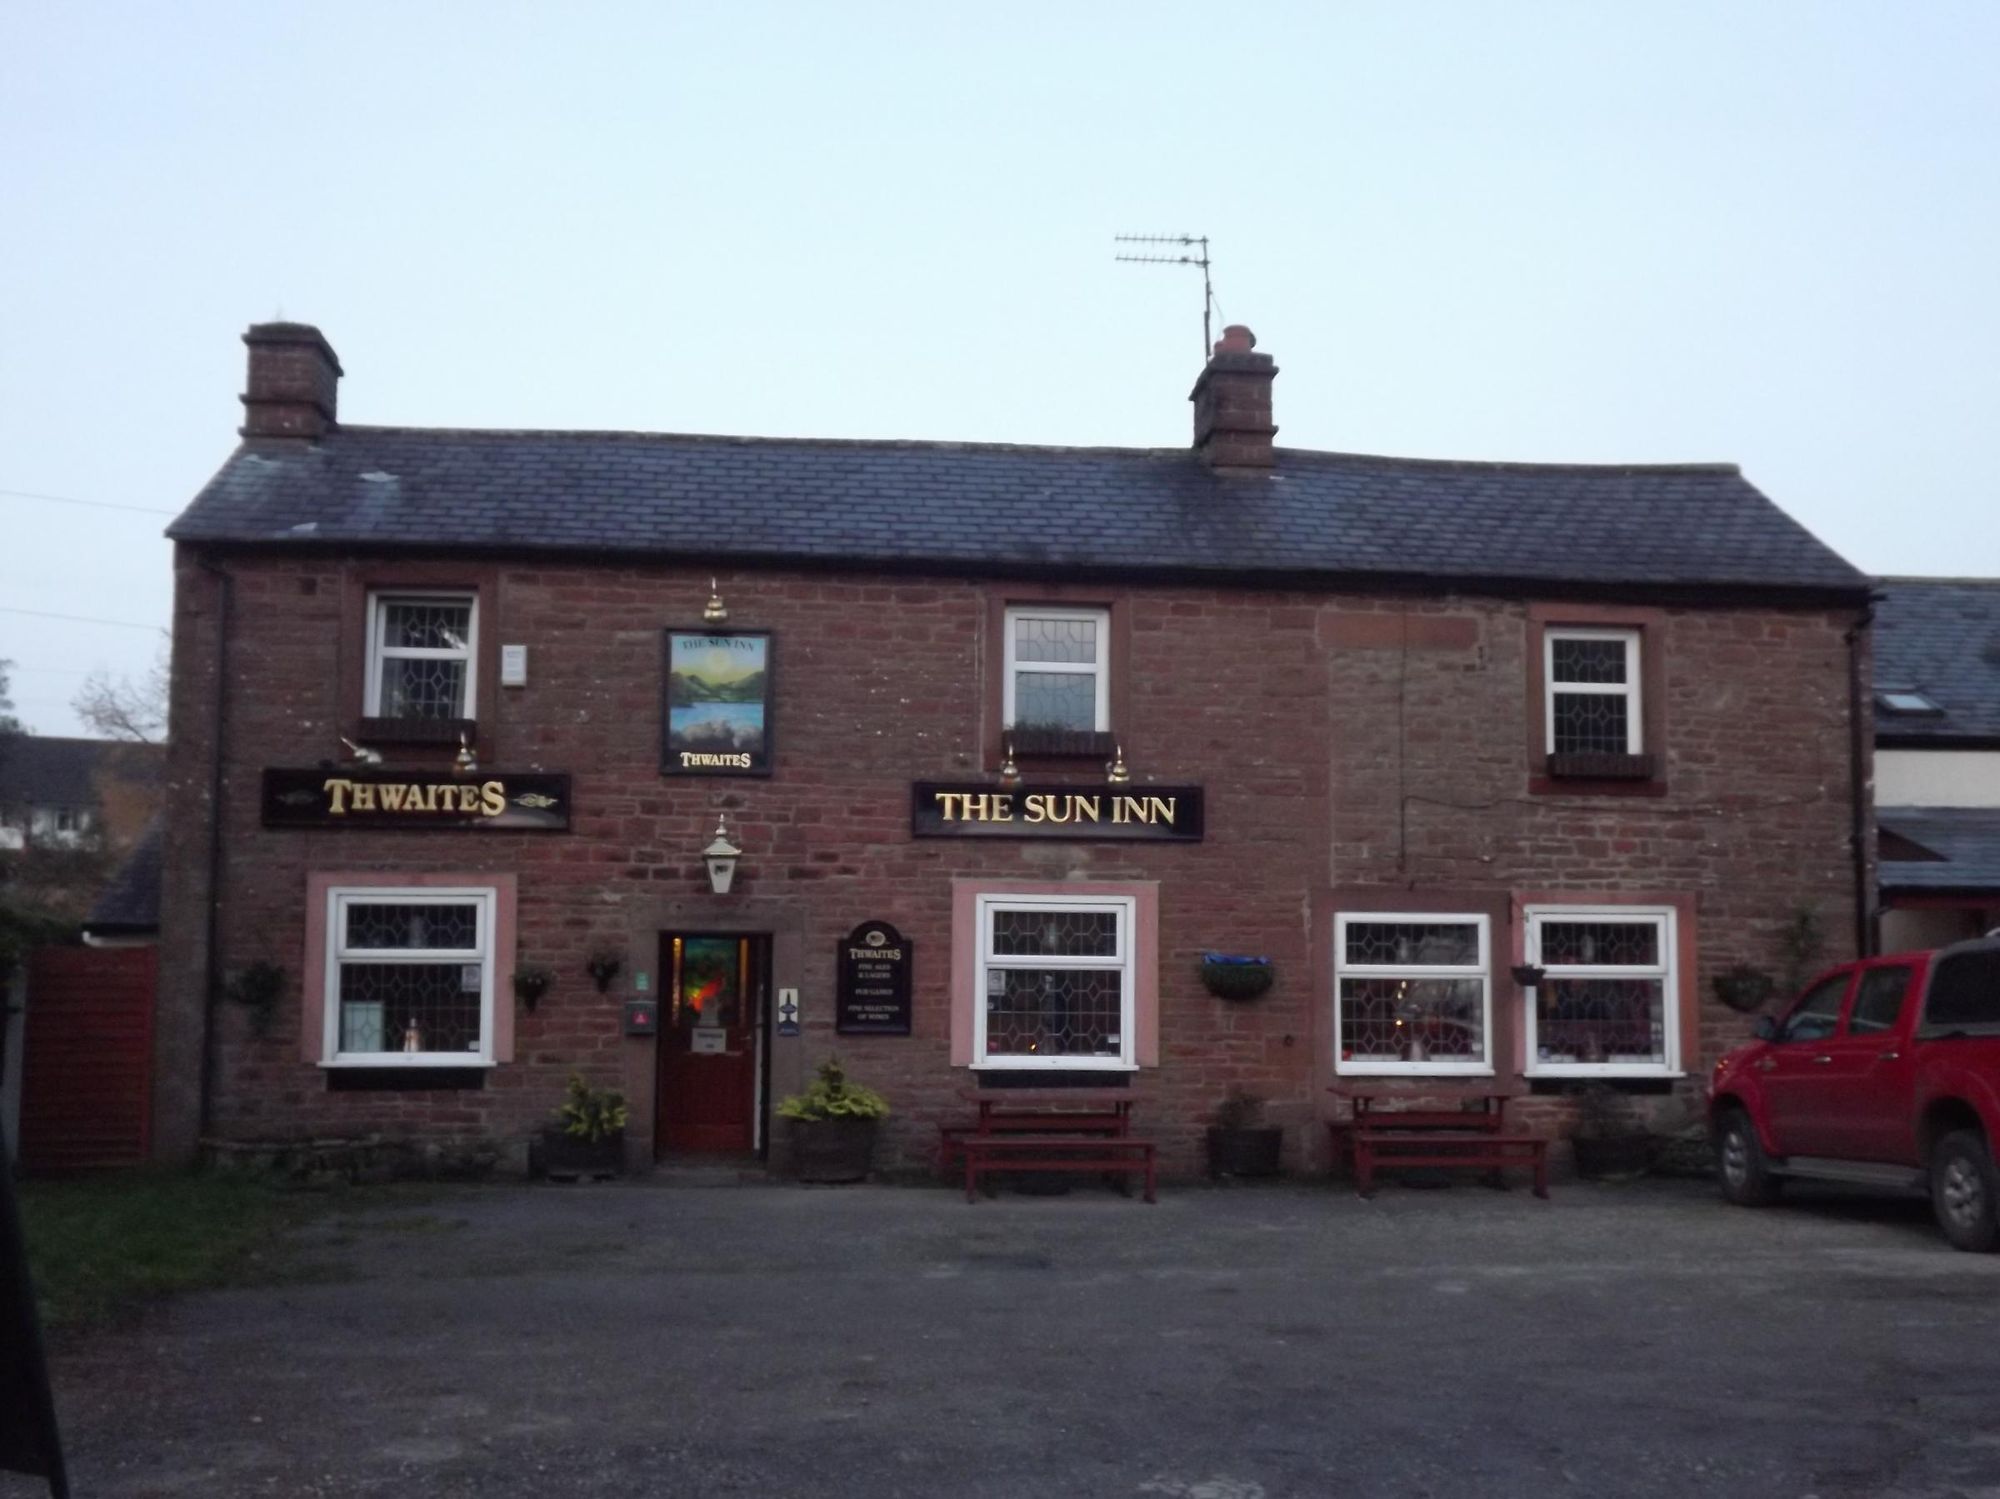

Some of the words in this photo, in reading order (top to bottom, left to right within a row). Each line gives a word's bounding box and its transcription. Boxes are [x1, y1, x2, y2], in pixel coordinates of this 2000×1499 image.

[709, 638, 731, 648] SUN
[680, 752, 752, 768] THWAITES
[324, 779, 507, 816] THWAITES
[935, 793, 1014, 822] THE
[1024, 795, 1101, 823] SUN
[1111, 796, 1177, 824] INN
[849, 948, 901, 960] THWAITES
